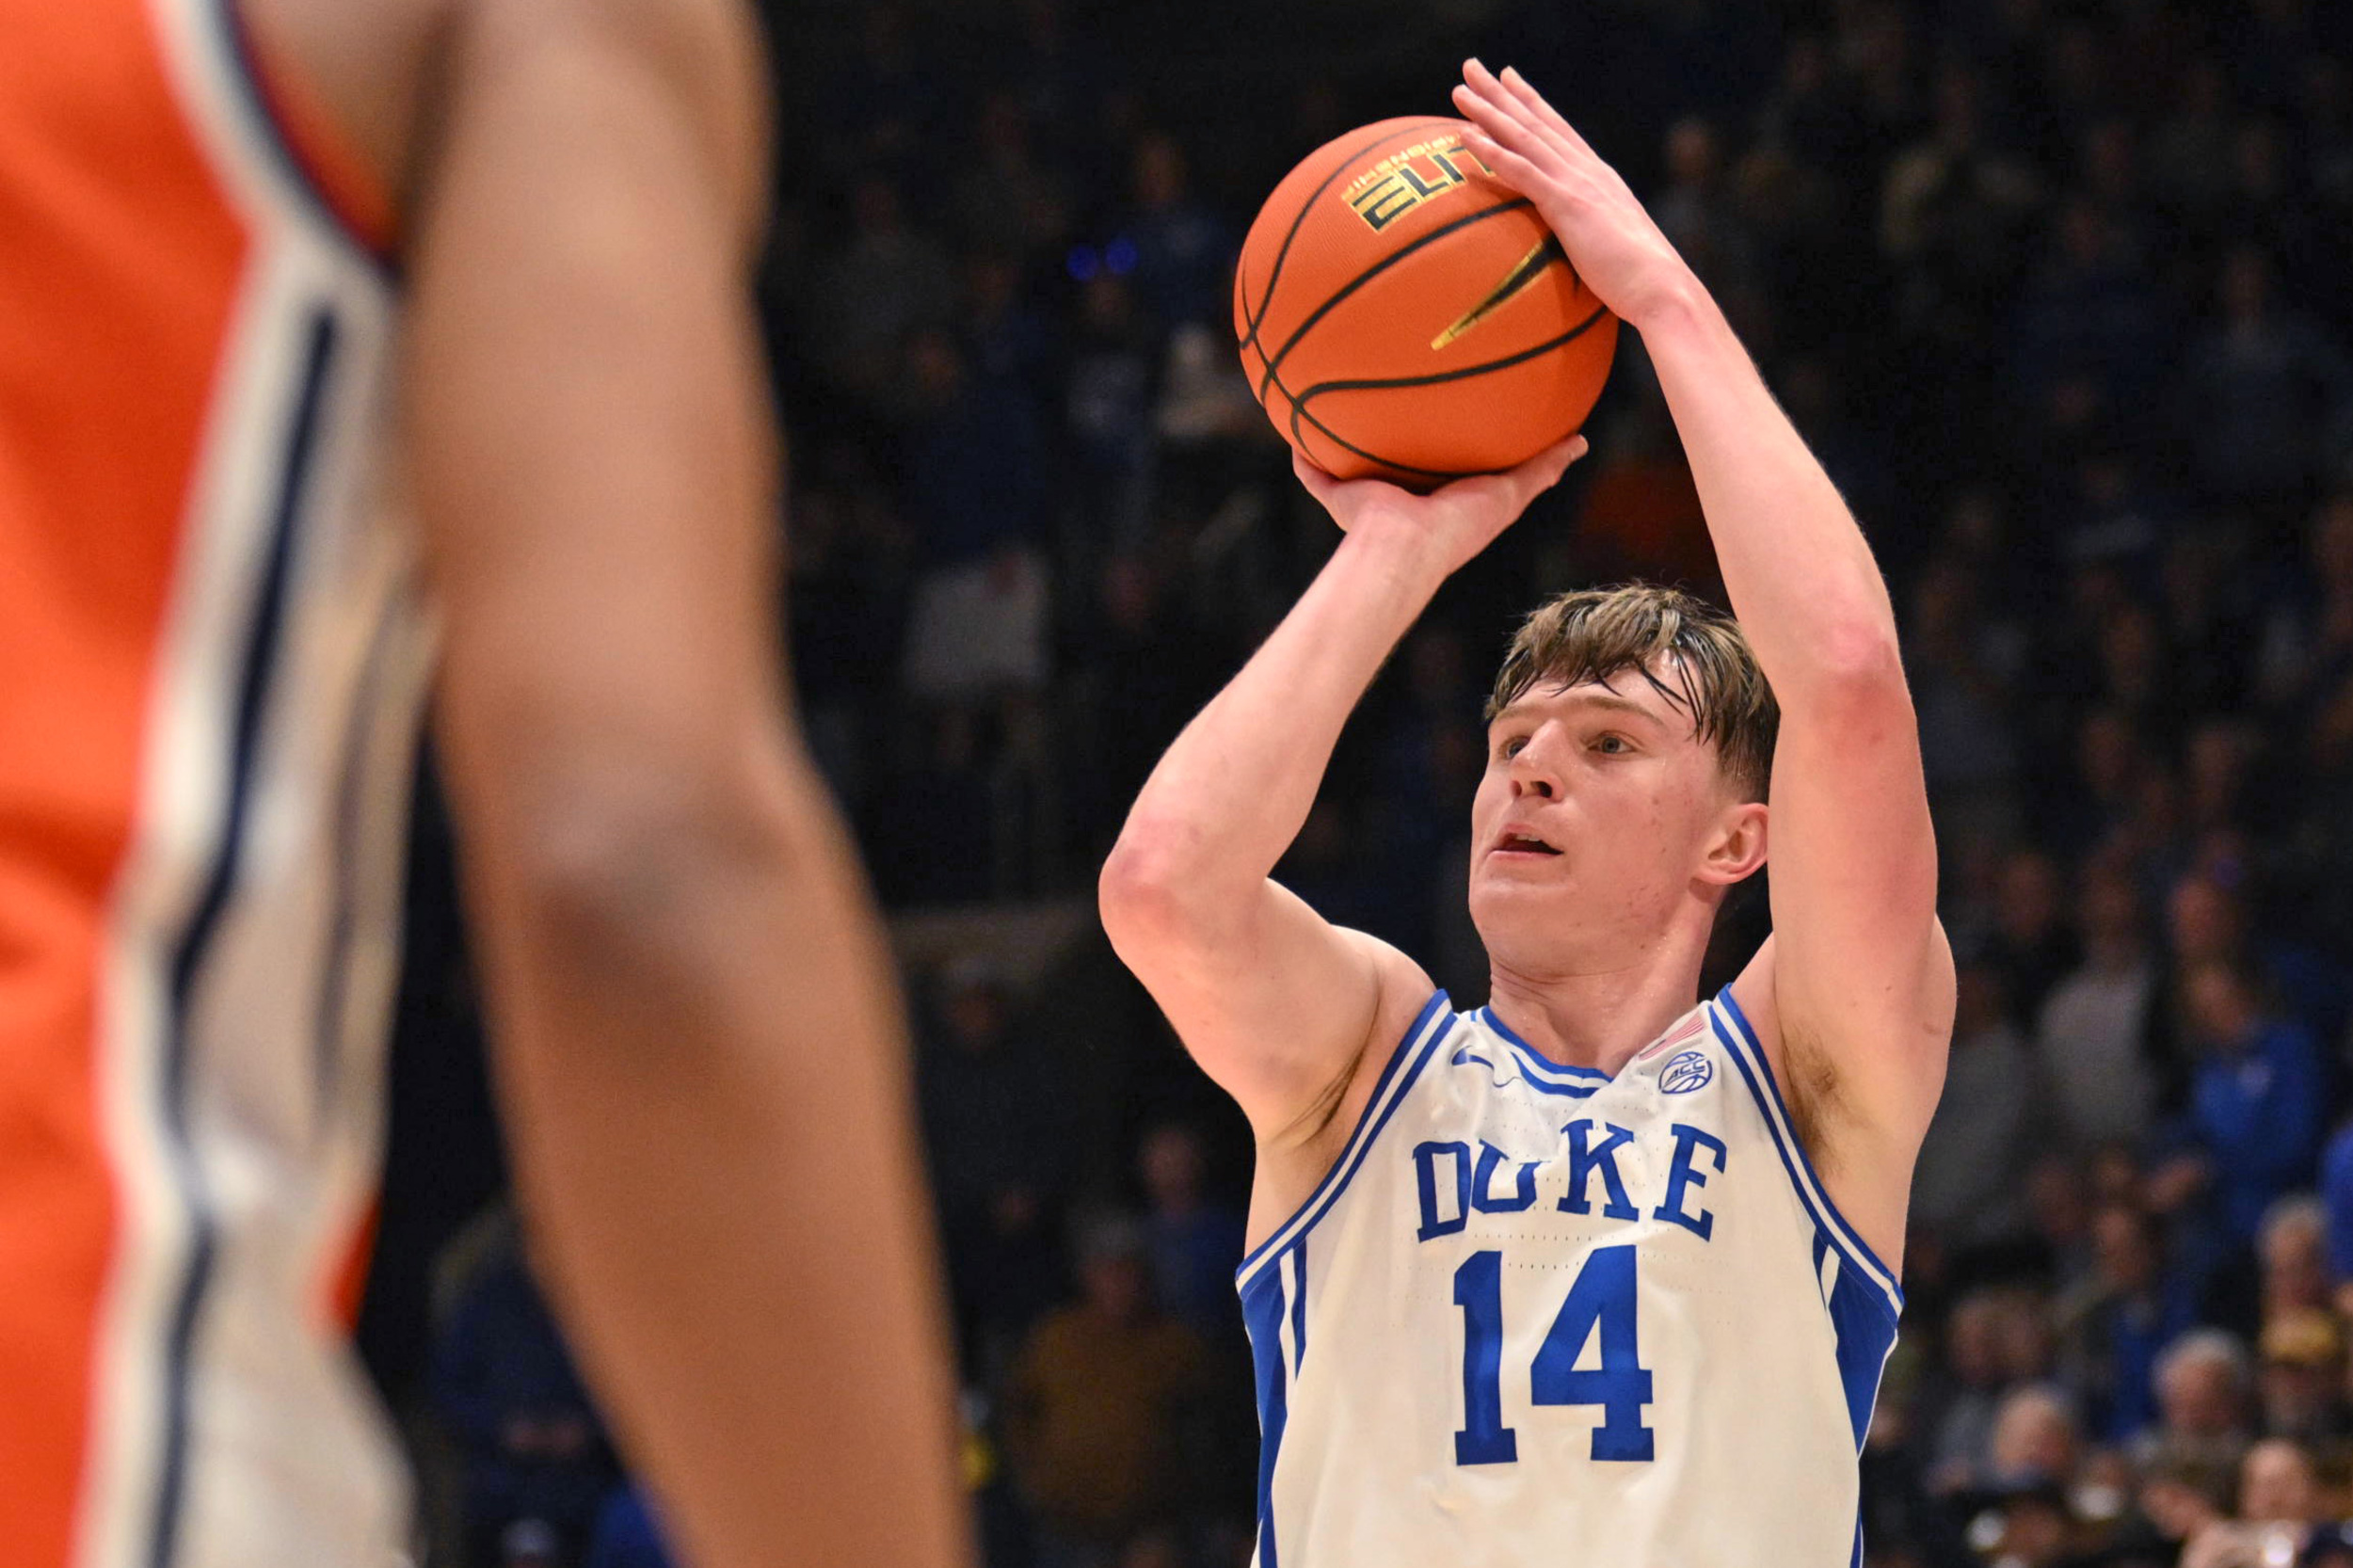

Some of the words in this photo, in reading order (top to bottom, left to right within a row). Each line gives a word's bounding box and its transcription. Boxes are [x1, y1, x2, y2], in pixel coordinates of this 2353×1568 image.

[1665, 1058, 1705, 1084] ACC
[1412, 1118, 1728, 1242] DUKE
[1453, 1244, 1655, 1465] 14
